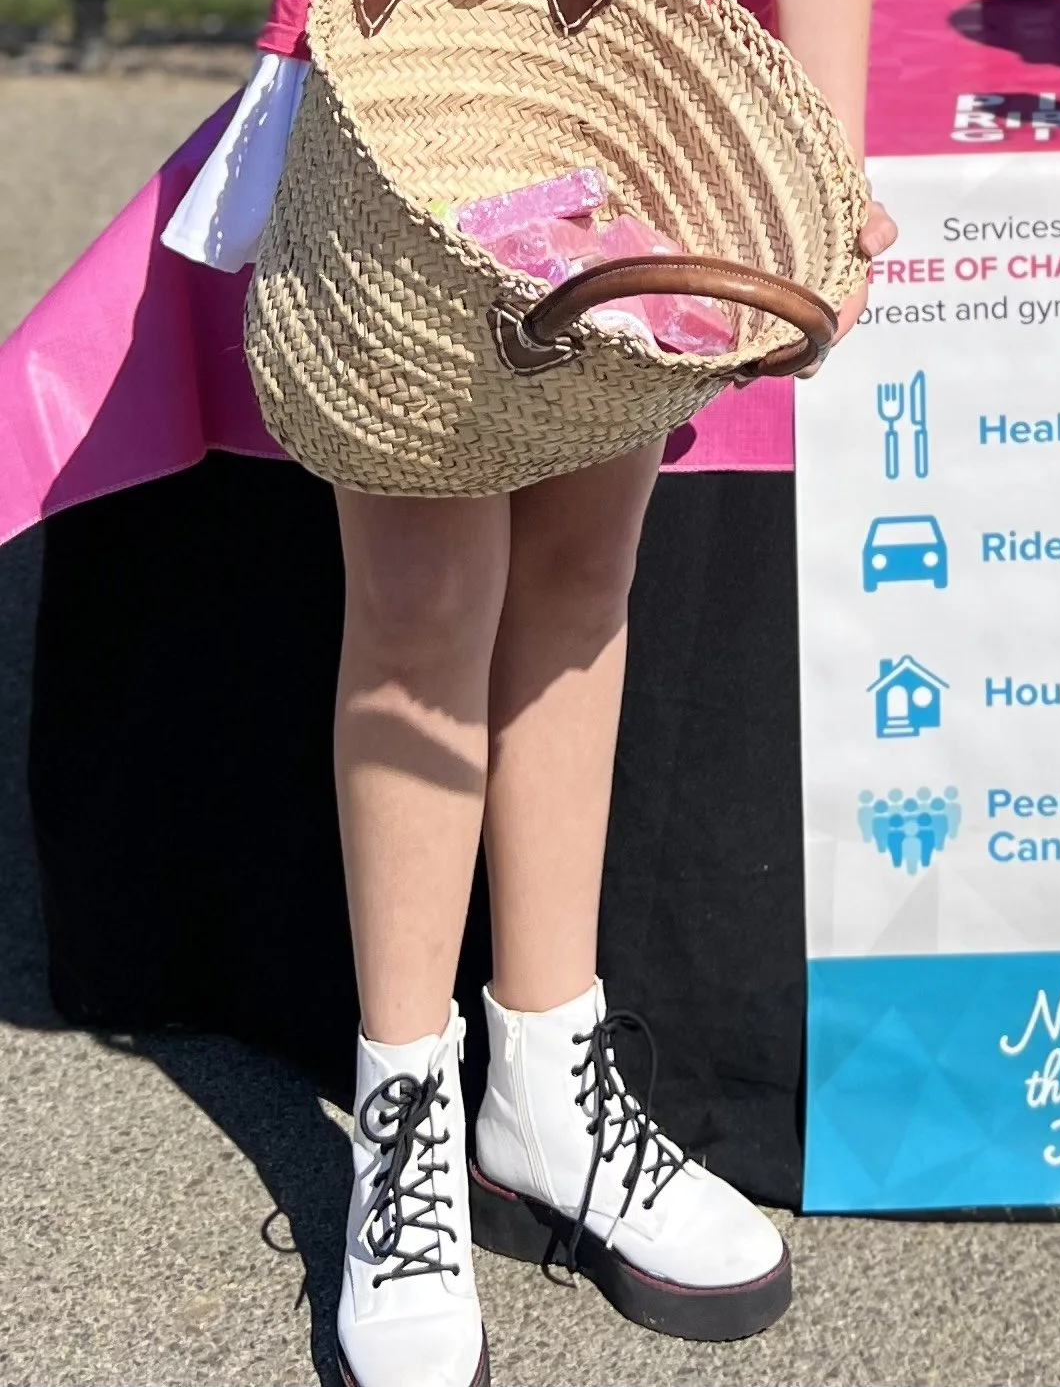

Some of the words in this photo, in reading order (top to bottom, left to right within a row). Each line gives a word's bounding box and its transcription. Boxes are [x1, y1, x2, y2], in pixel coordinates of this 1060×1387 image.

[867, 258, 945, 285] FREE
[954, 256, 998, 282] OF
[955, 296, 1008, 321] and
